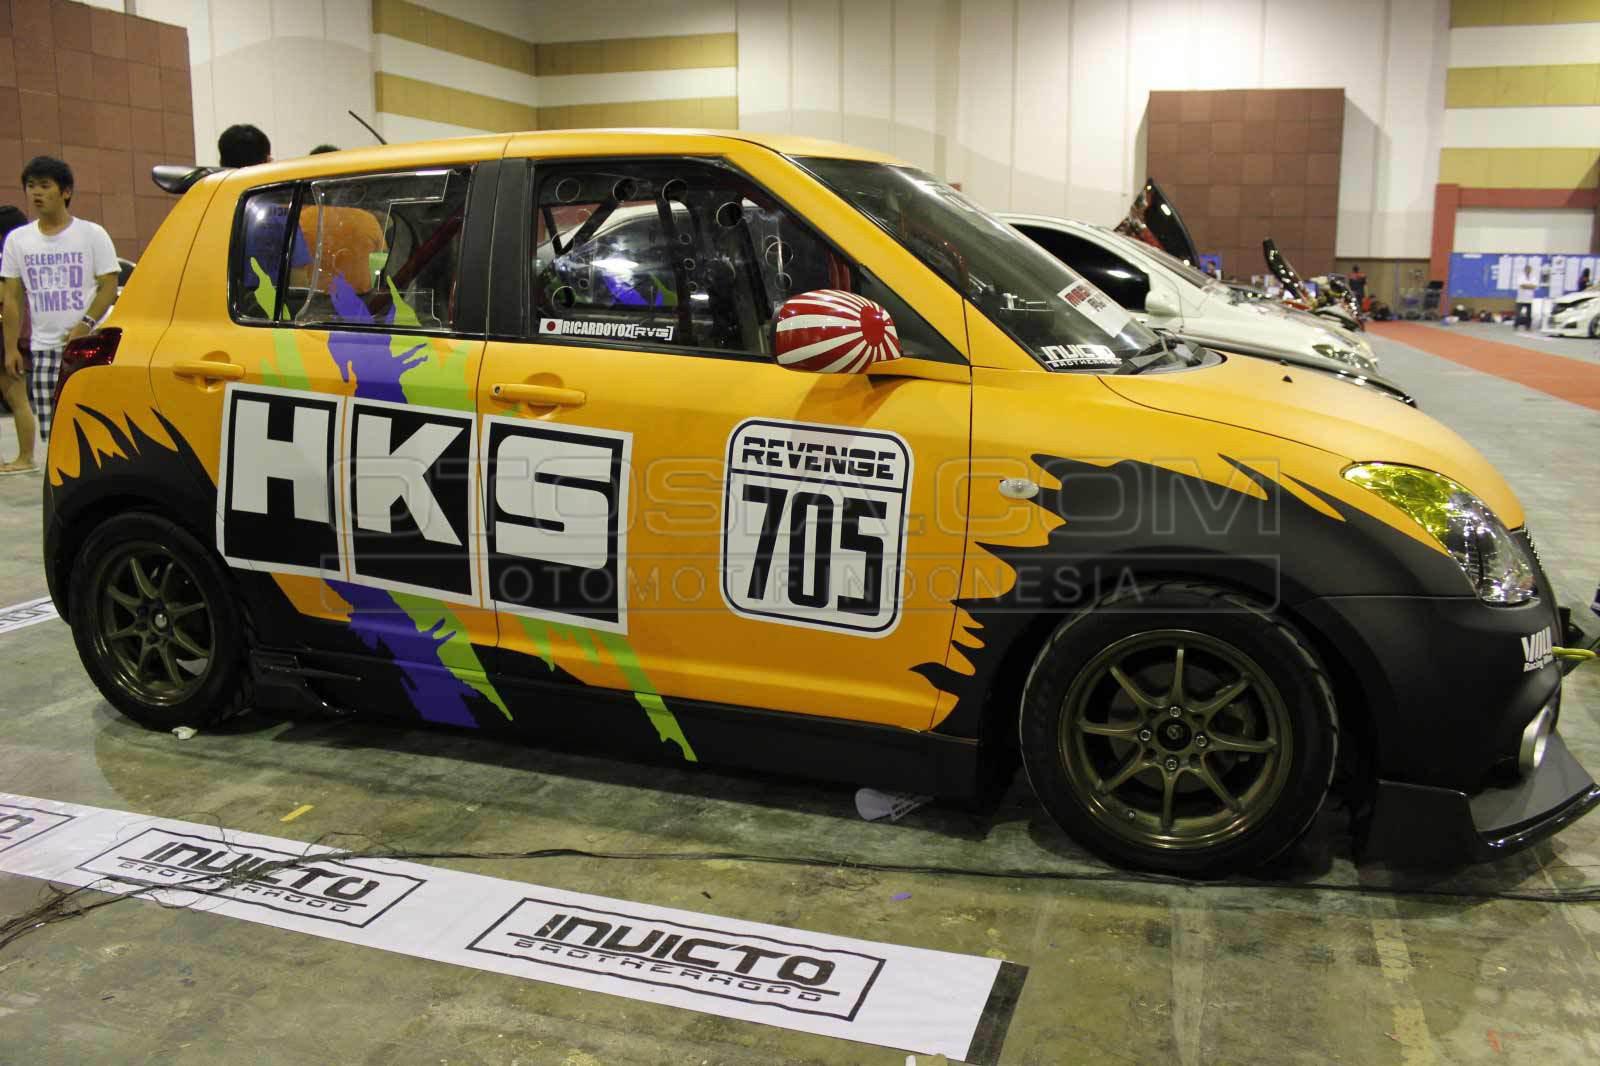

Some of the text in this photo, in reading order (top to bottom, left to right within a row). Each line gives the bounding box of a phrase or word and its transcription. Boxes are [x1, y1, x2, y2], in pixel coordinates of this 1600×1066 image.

[24, 252, 84, 266] CELEBRATE
[27, 265, 84, 290] GOOD
[31, 290, 84, 312] TIMES
[231, 399, 614, 570] HKS
[741, 436, 896, 480] REVENGE
[742, 484, 888, 616] 705
[514, 939, 823, 1002] BROTHERHOOD
[534, 914, 836, 986] INVICTO
